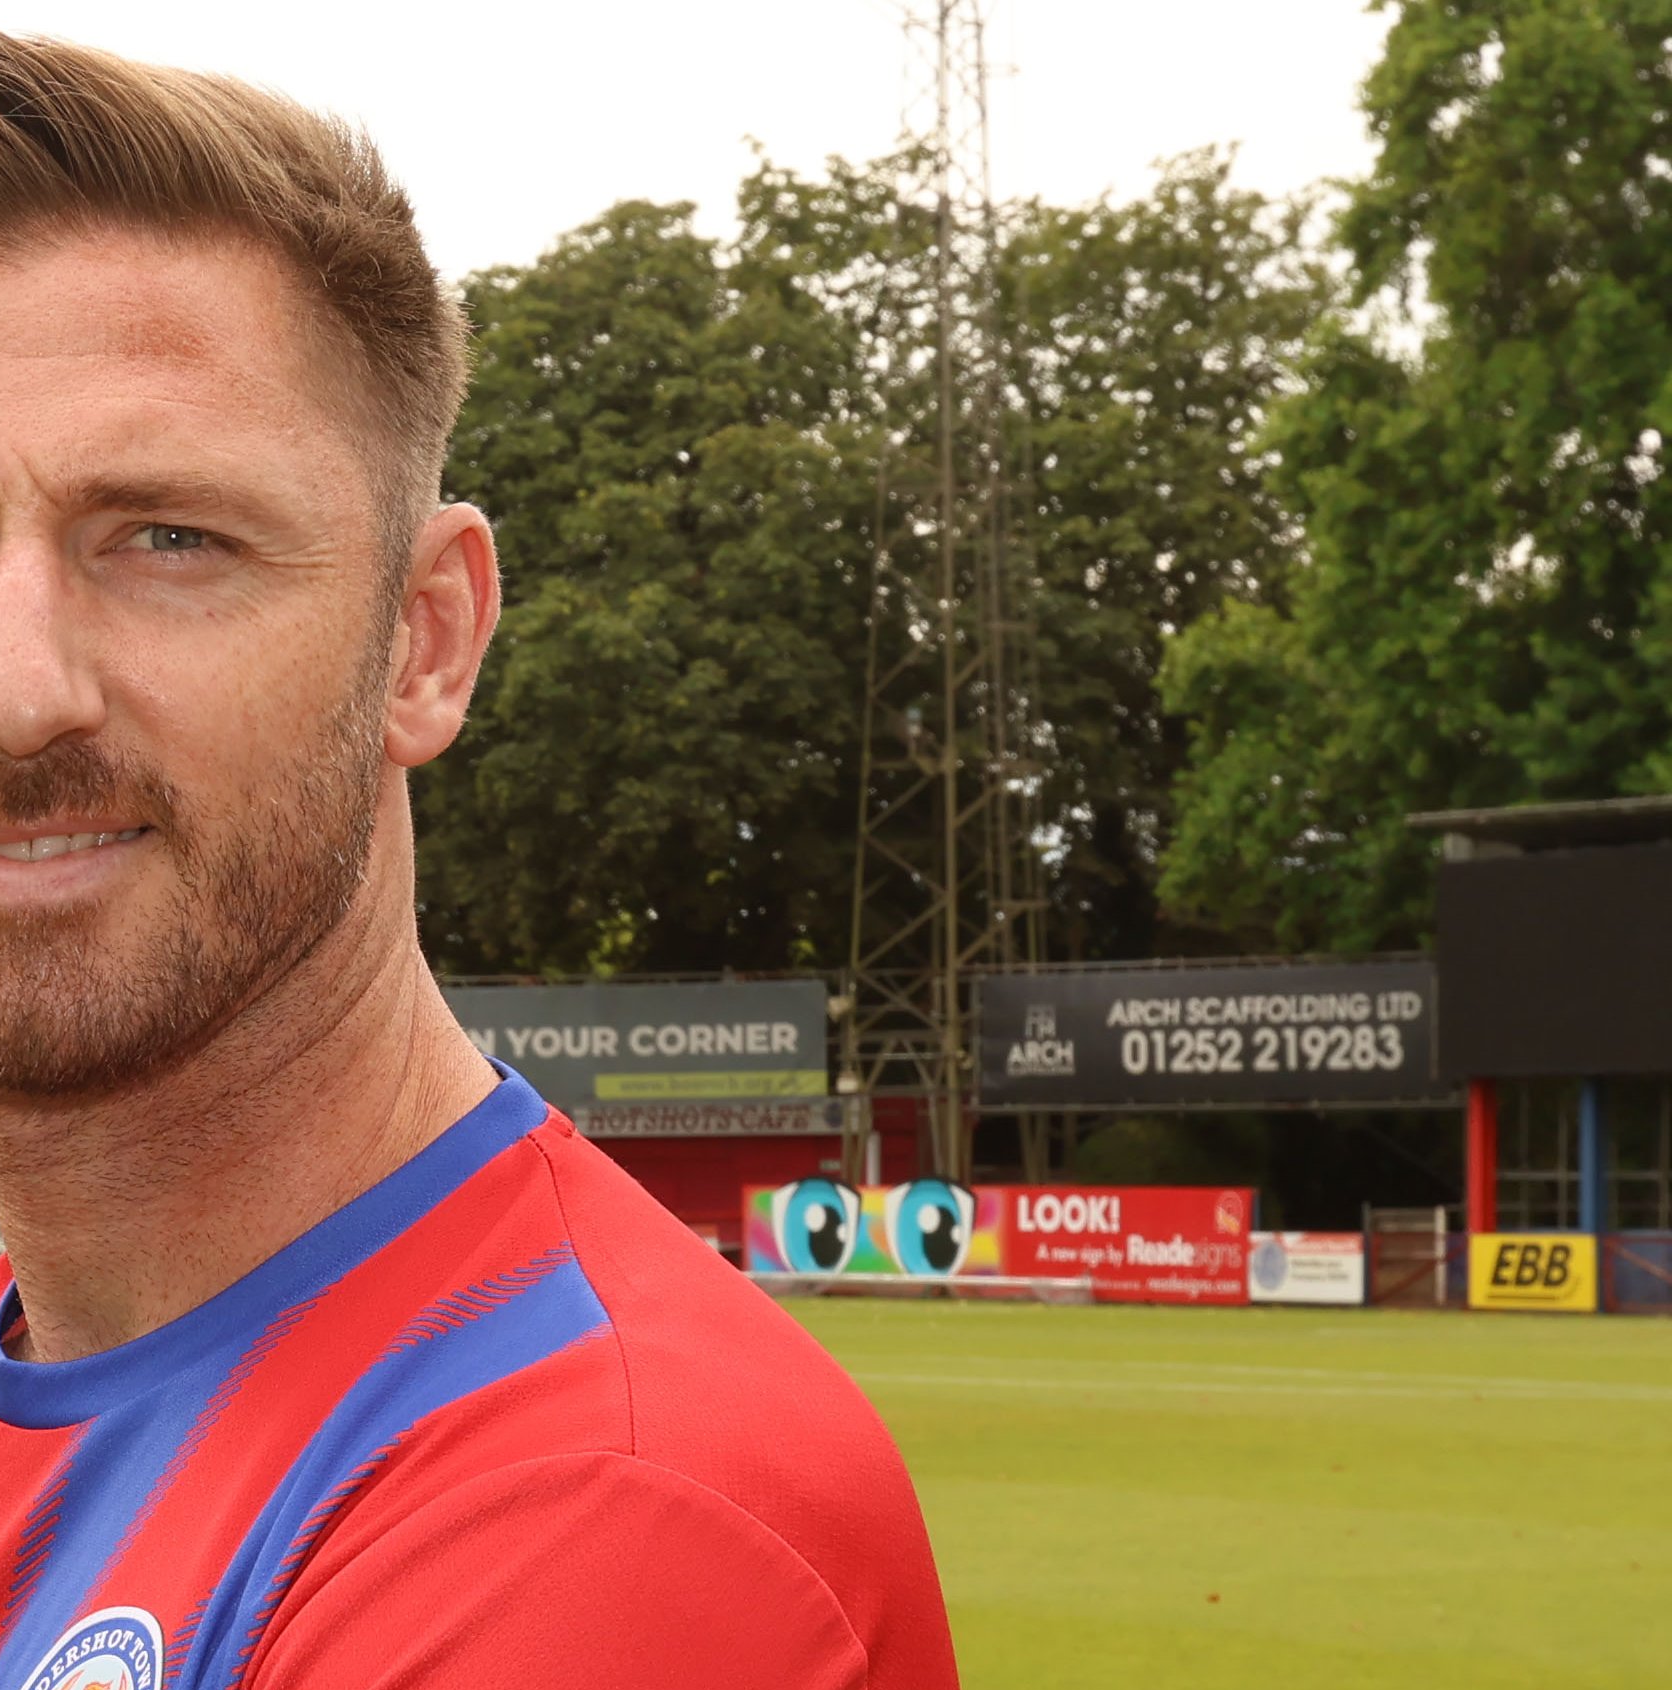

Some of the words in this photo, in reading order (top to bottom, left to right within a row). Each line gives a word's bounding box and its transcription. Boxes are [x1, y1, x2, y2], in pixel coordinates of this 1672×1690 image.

[1107, 997, 1181, 1027] ARCH
[1185, 993, 1371, 1026] SCAFFOLDING
[1377, 992, 1422, 1020] LTD
[505, 1026, 618, 1058] YOUR
[630, 1022, 798, 1055] CORNER
[1007, 1040, 1074, 1066] ARCH
[1121, 1029, 1243, 1074] 01252
[1253, 1025, 1403, 1073] 219283
[1018, 1194, 1121, 1233] LOOK!
[1036, 1244, 1049, 1260] A
[1491, 1243, 1571, 1287] EBB
